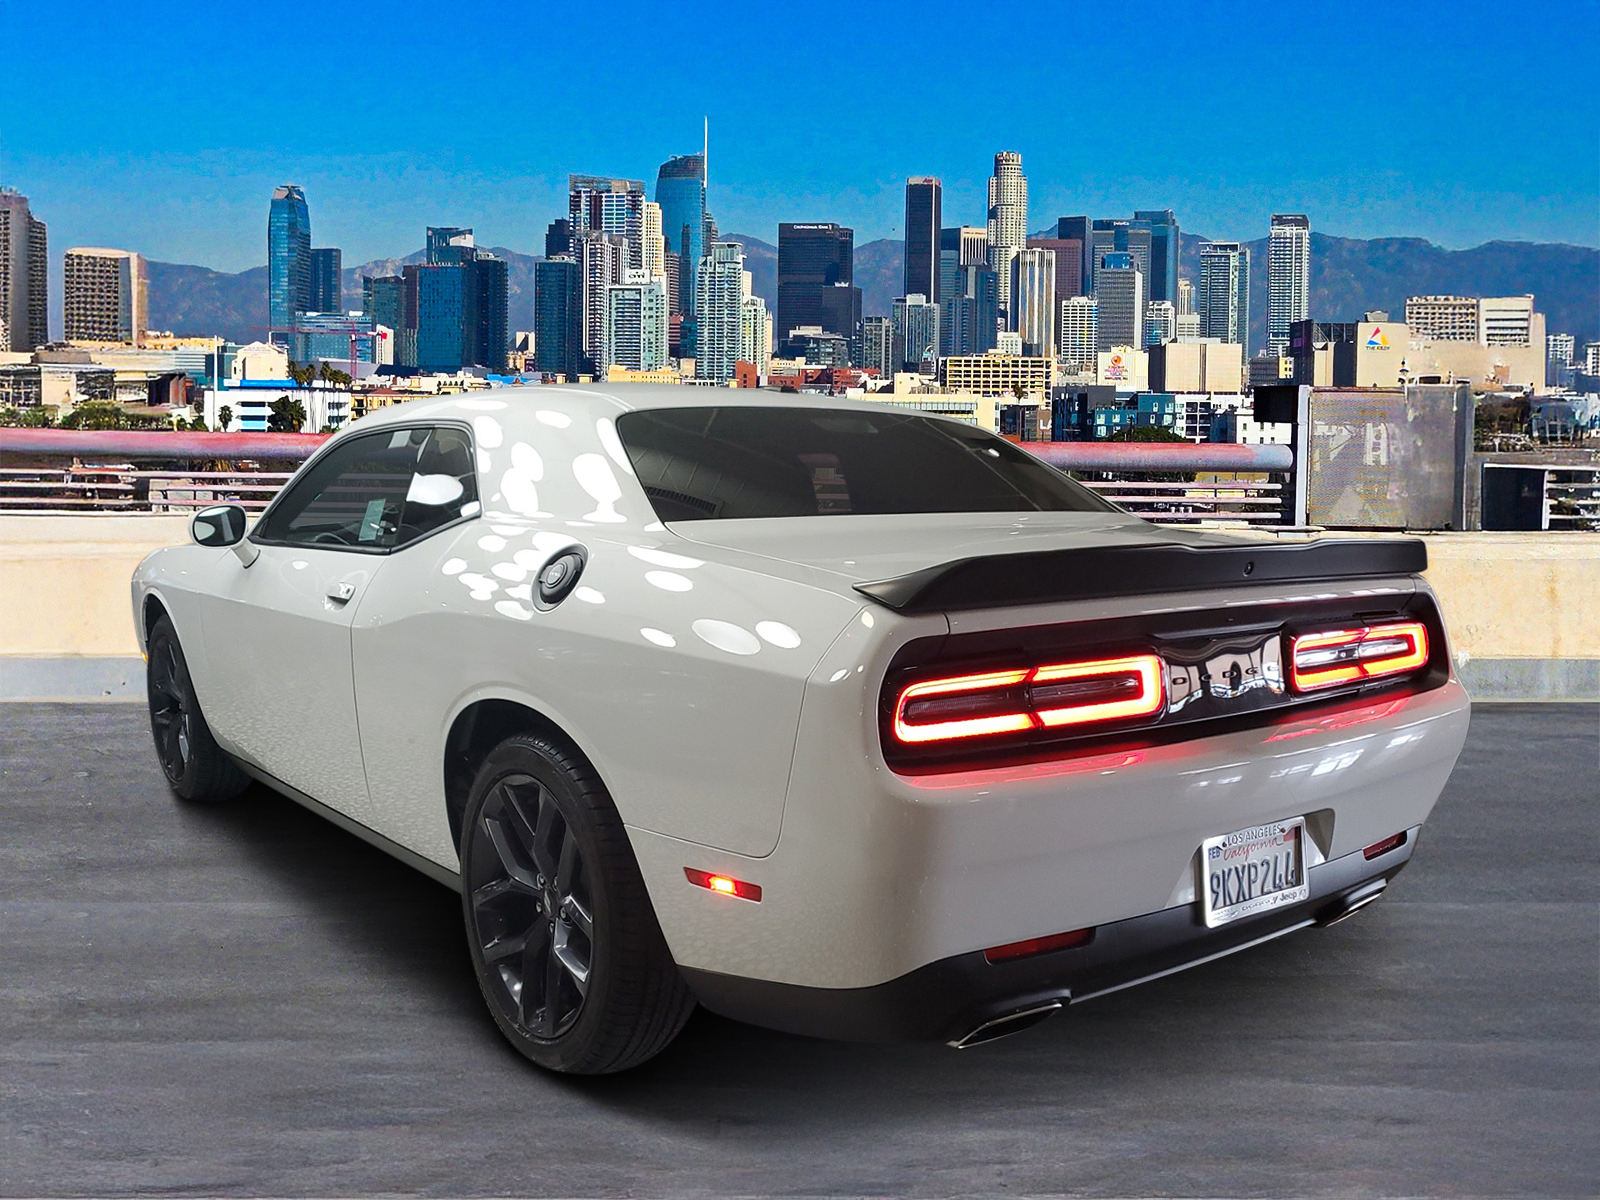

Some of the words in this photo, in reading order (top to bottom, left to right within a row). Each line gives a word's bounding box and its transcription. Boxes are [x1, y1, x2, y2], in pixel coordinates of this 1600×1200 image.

[1171, 664, 1279, 686] DODGE
[1227, 835, 1243, 847] LOS
[1245, 823, 1282, 843] ANGELES
[1279, 891, 1298, 902] Jeep
